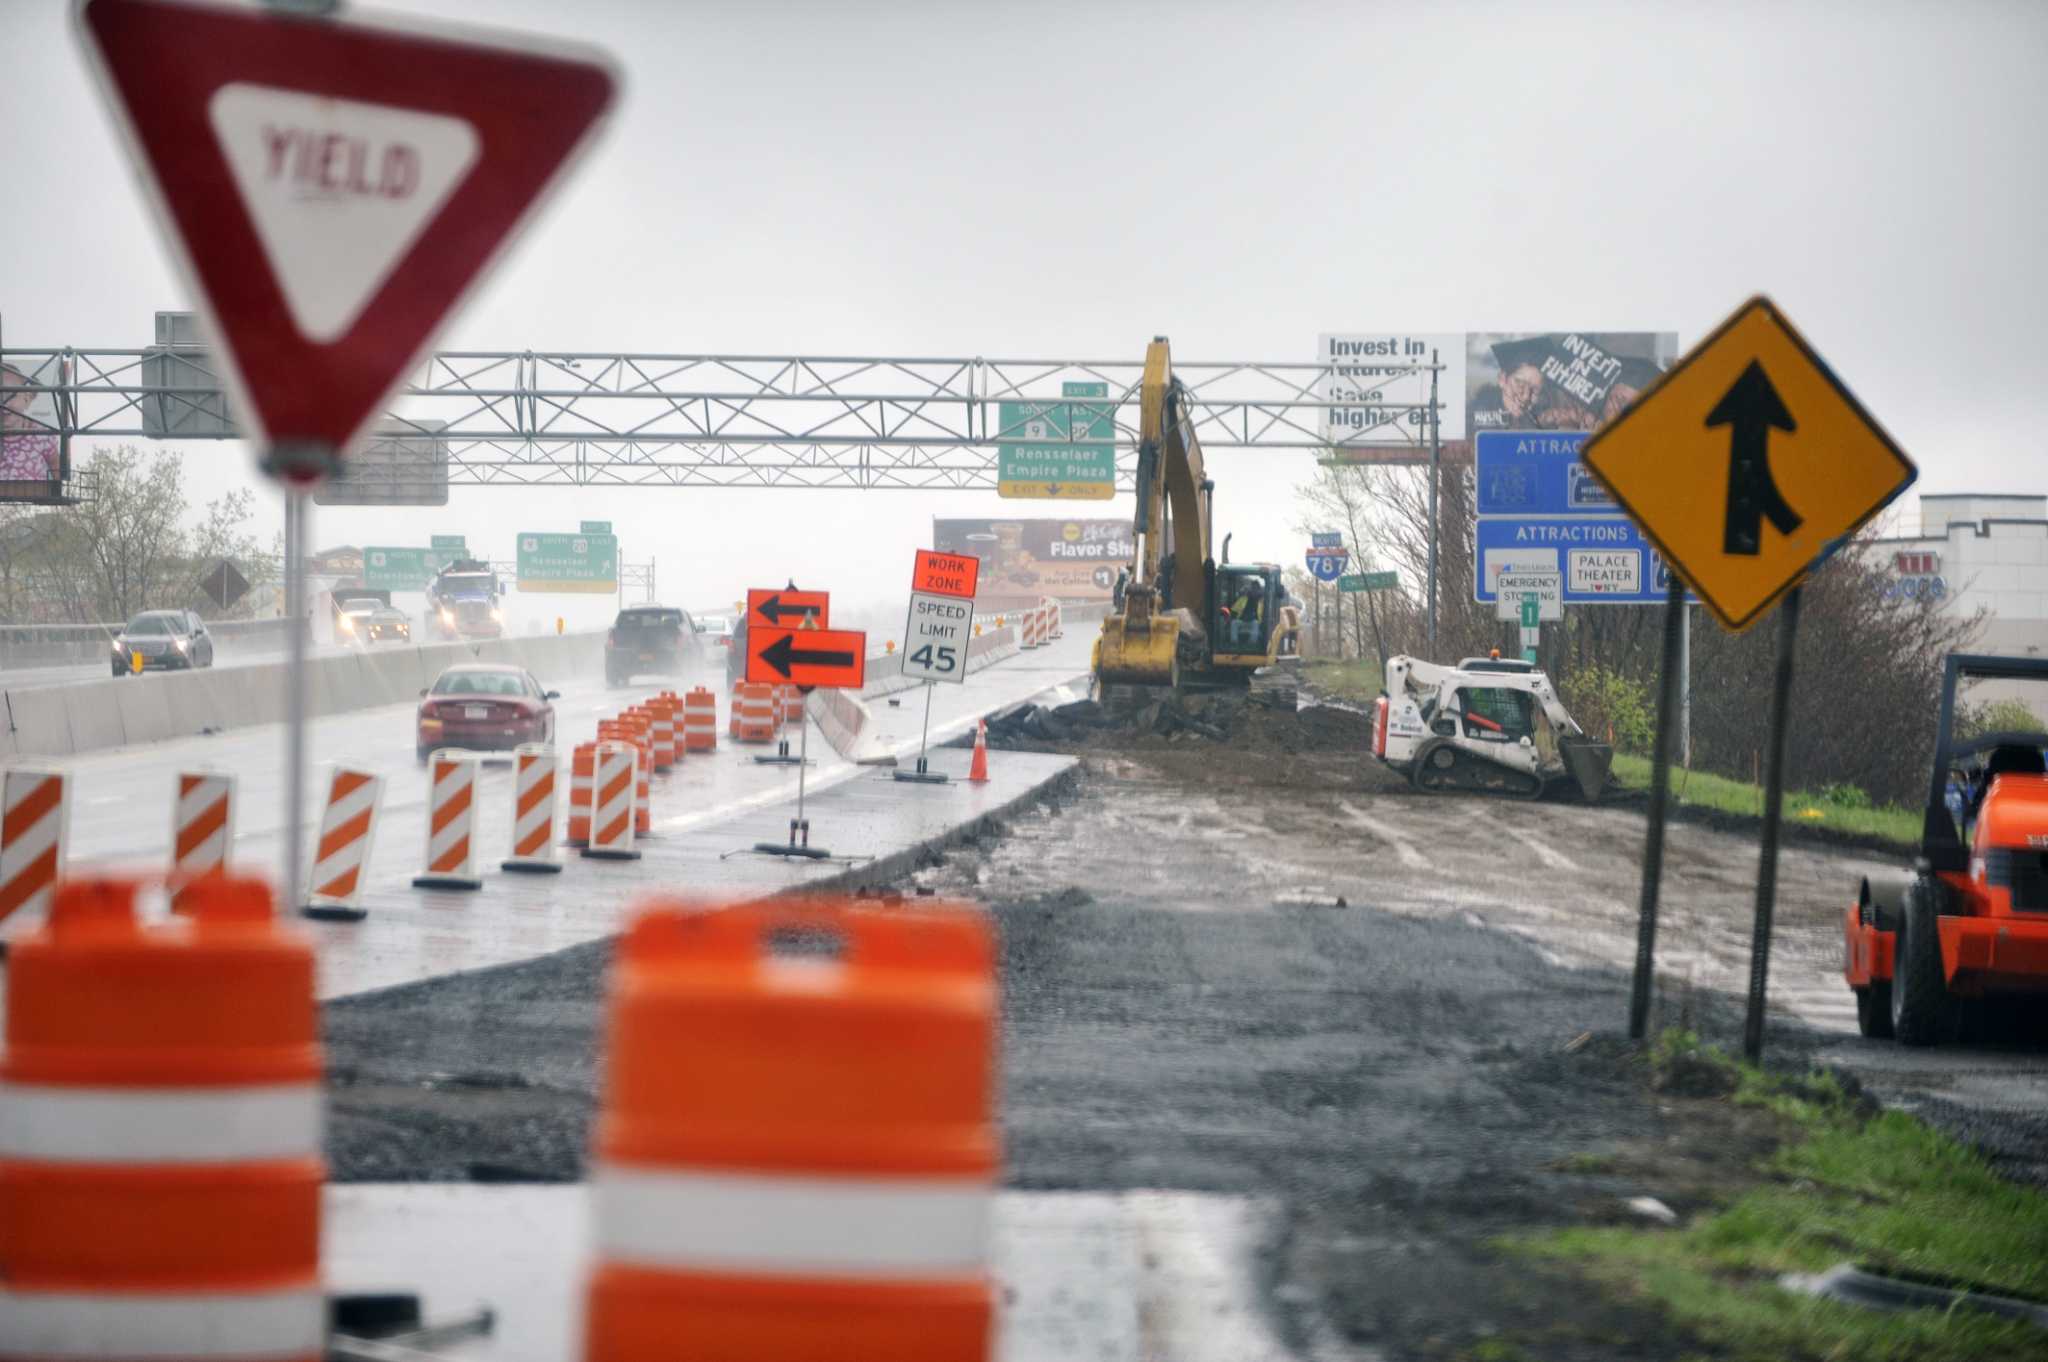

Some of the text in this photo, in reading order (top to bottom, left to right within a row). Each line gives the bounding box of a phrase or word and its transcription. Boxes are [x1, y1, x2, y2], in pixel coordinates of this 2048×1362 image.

[259, 122, 424, 201] YIELD
[1329, 337, 1425, 356] Invest in
[1095, 386, 1105, 398] 3
[1329, 406, 1399, 429] higher
[1014, 447, 1099, 461] Rensselaer
[1515, 439, 1584, 455] ATTRAC
[1006, 464, 1108, 480] Empire Plaza
[1515, 525, 1629, 542] ATTRACTIONS
[1050, 541, 1102, 557] Flavor
[927, 557, 966, 573] WORK
[1308, 556, 1347, 575] 787
[1579, 554, 1629, 568] PALACE
[926, 575, 964, 591] ZONE
[1499, 577, 1558, 589] EMERGENCY
[1576, 568, 1633, 582] THEATER
[917, 601, 967, 620] SPEED
[920, 623, 958, 639] LIMIT
[909, 643, 957, 673] 45
